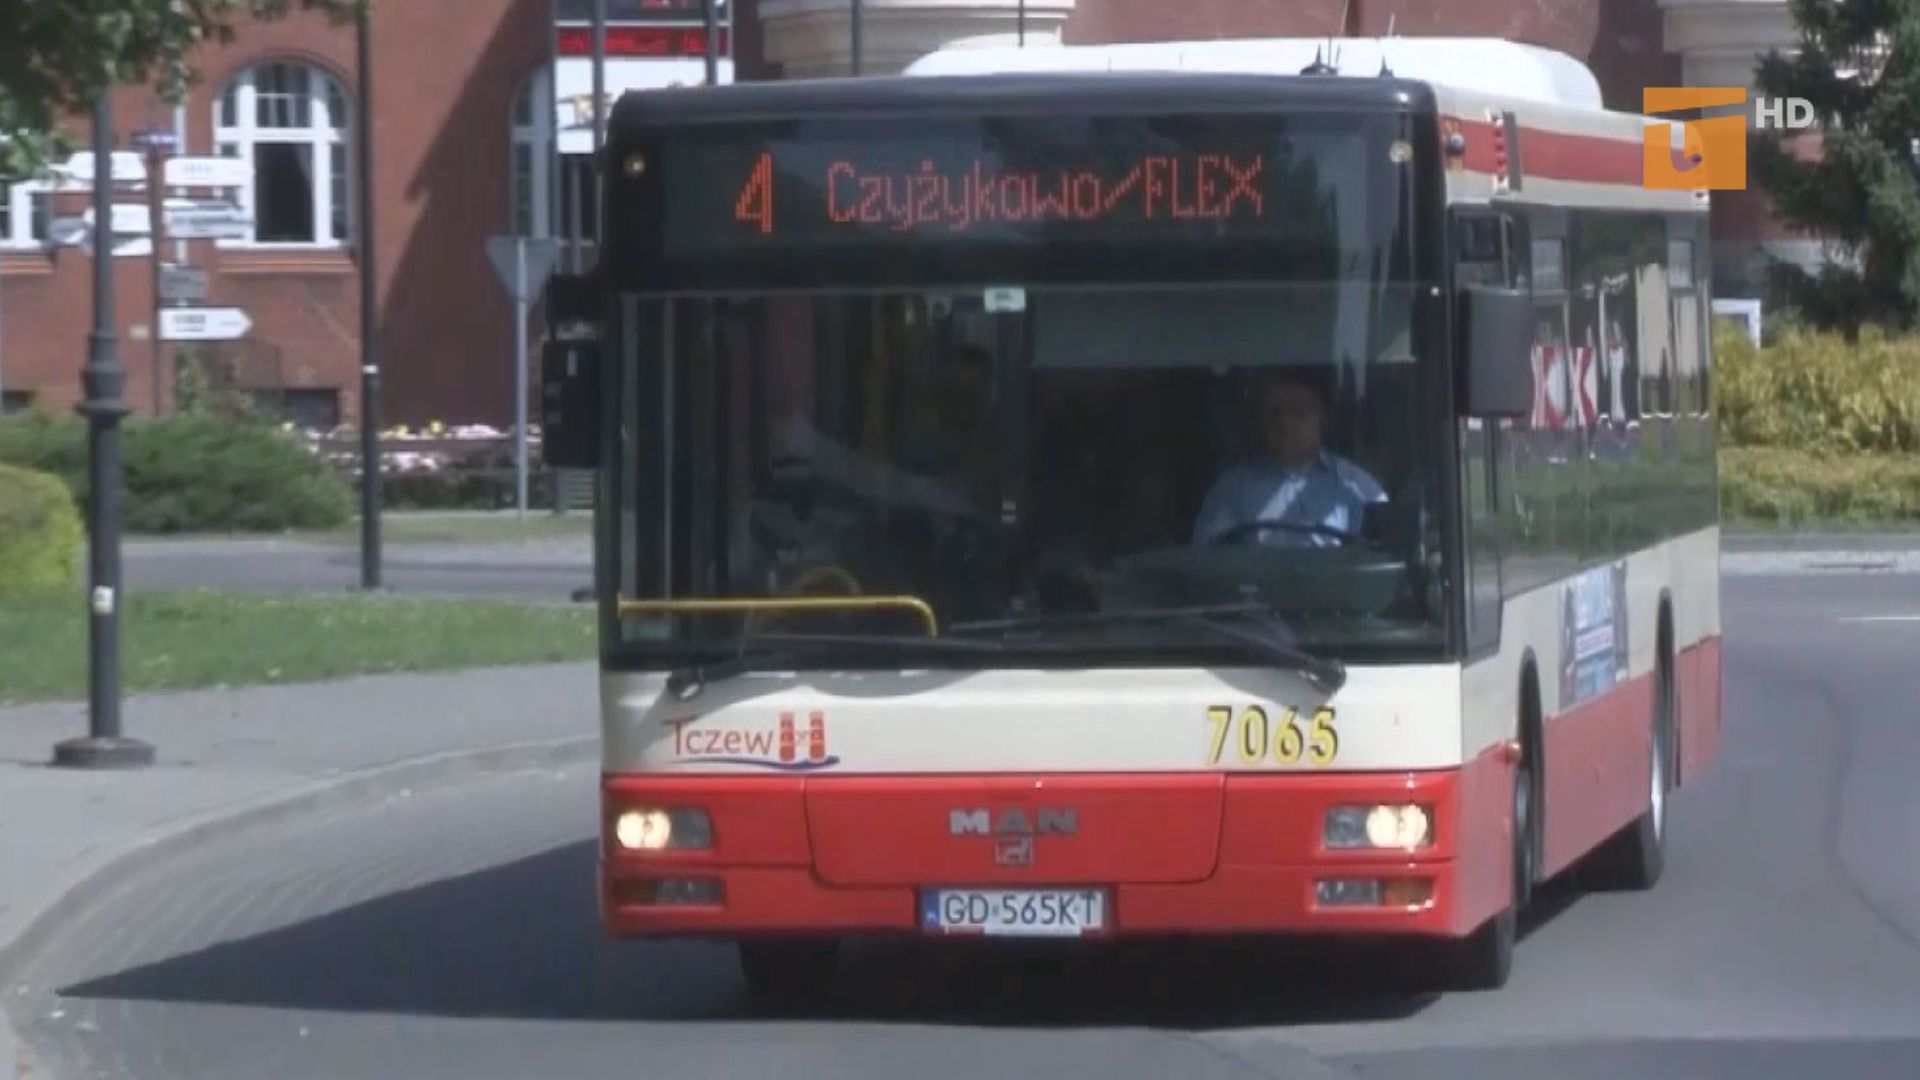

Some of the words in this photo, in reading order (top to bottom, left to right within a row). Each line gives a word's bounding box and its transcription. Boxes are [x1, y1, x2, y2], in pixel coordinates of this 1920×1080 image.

[735, 153, 773, 233] 4
[828, 154, 1262, 231] Czyżykowo/FLEX
[661, 715, 774, 756] Tczew
[1206, 705, 1338, 766] 7065
[949, 808, 1078, 836] MAN
[945, 894, 989, 924] GD
